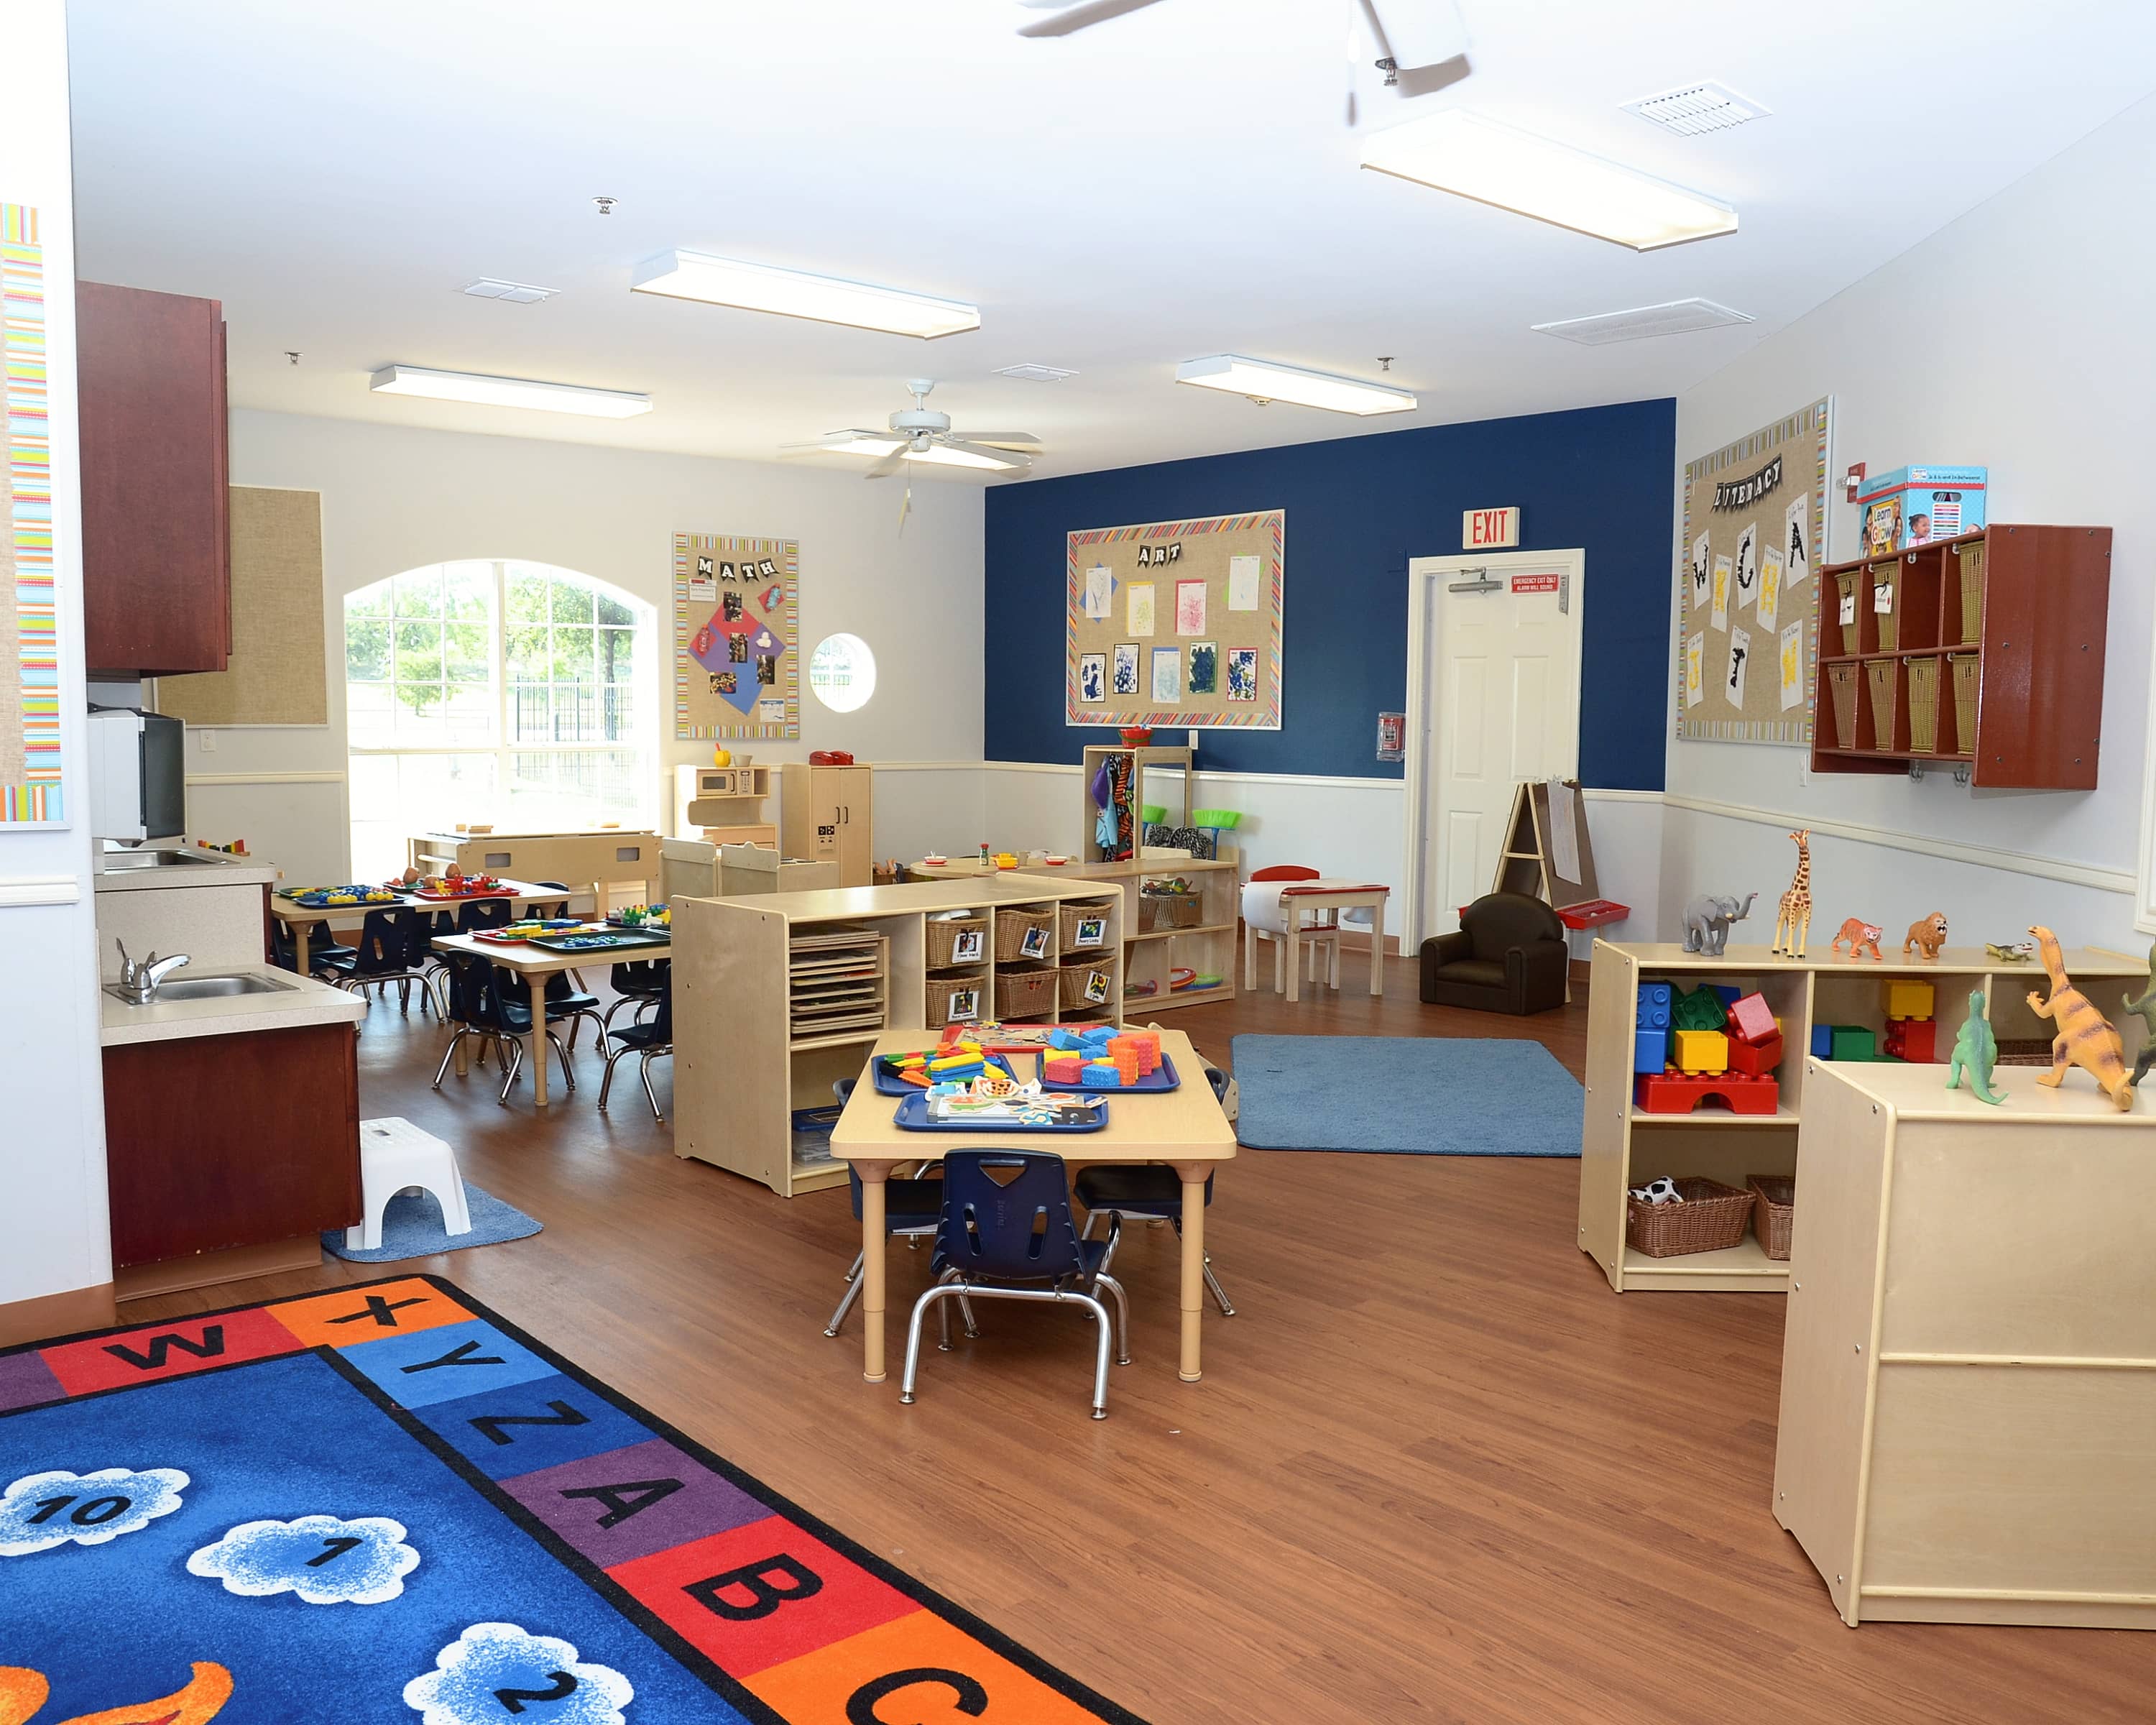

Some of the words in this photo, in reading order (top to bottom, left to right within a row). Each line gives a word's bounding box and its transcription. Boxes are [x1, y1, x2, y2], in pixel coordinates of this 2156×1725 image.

[1714, 460, 1781, 506] LITERACY
[1473, 510, 1507, 543] EXIT
[1872, 525, 1892, 542] Grow
[1874, 508, 1891, 522] Learn
[1139, 545, 1180, 562] ART
[1736, 536, 1754, 589] C
[1789, 521, 1805, 568] A
[698, 558, 775, 578] MATH
[324, 1296, 430, 1326] X
[103, 1325, 224, 1370] W
[400, 1340, 506, 1374] Y
[467, 1400, 591, 1445] Z
[27, 1495, 132, 1526] 10
[560, 1477, 685, 1530] A
[306, 1537, 362, 1567] 1
[681, 1552, 824, 1622] B
[493, 1670, 578, 1714] 2
[846, 1668, 988, 1725] C
